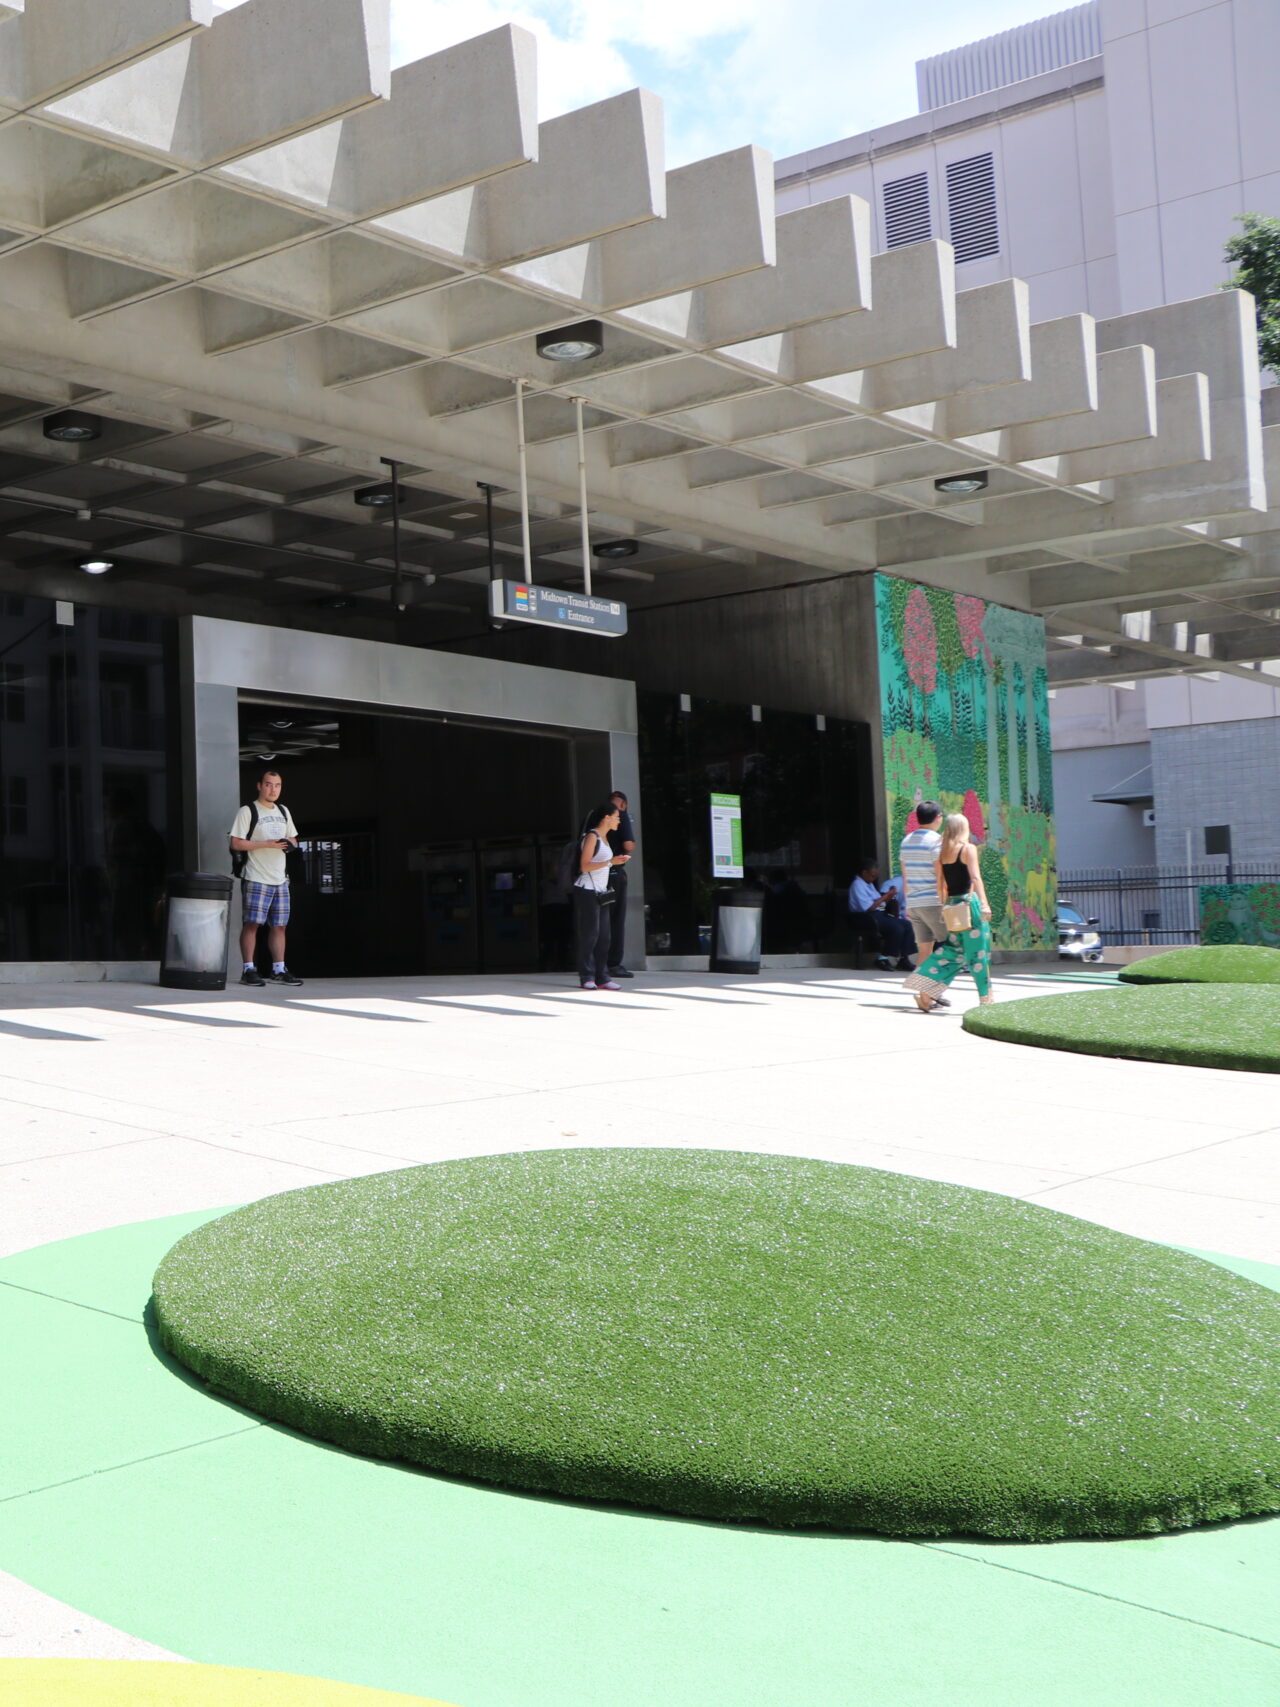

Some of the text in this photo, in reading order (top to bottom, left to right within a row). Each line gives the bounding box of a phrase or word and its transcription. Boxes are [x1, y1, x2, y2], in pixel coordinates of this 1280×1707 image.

[541, 590, 568, 605] Midtown
[568, 595, 589, 608] Transit
[589, 600, 611, 613] Station
[568, 609, 595, 624] Entrance
